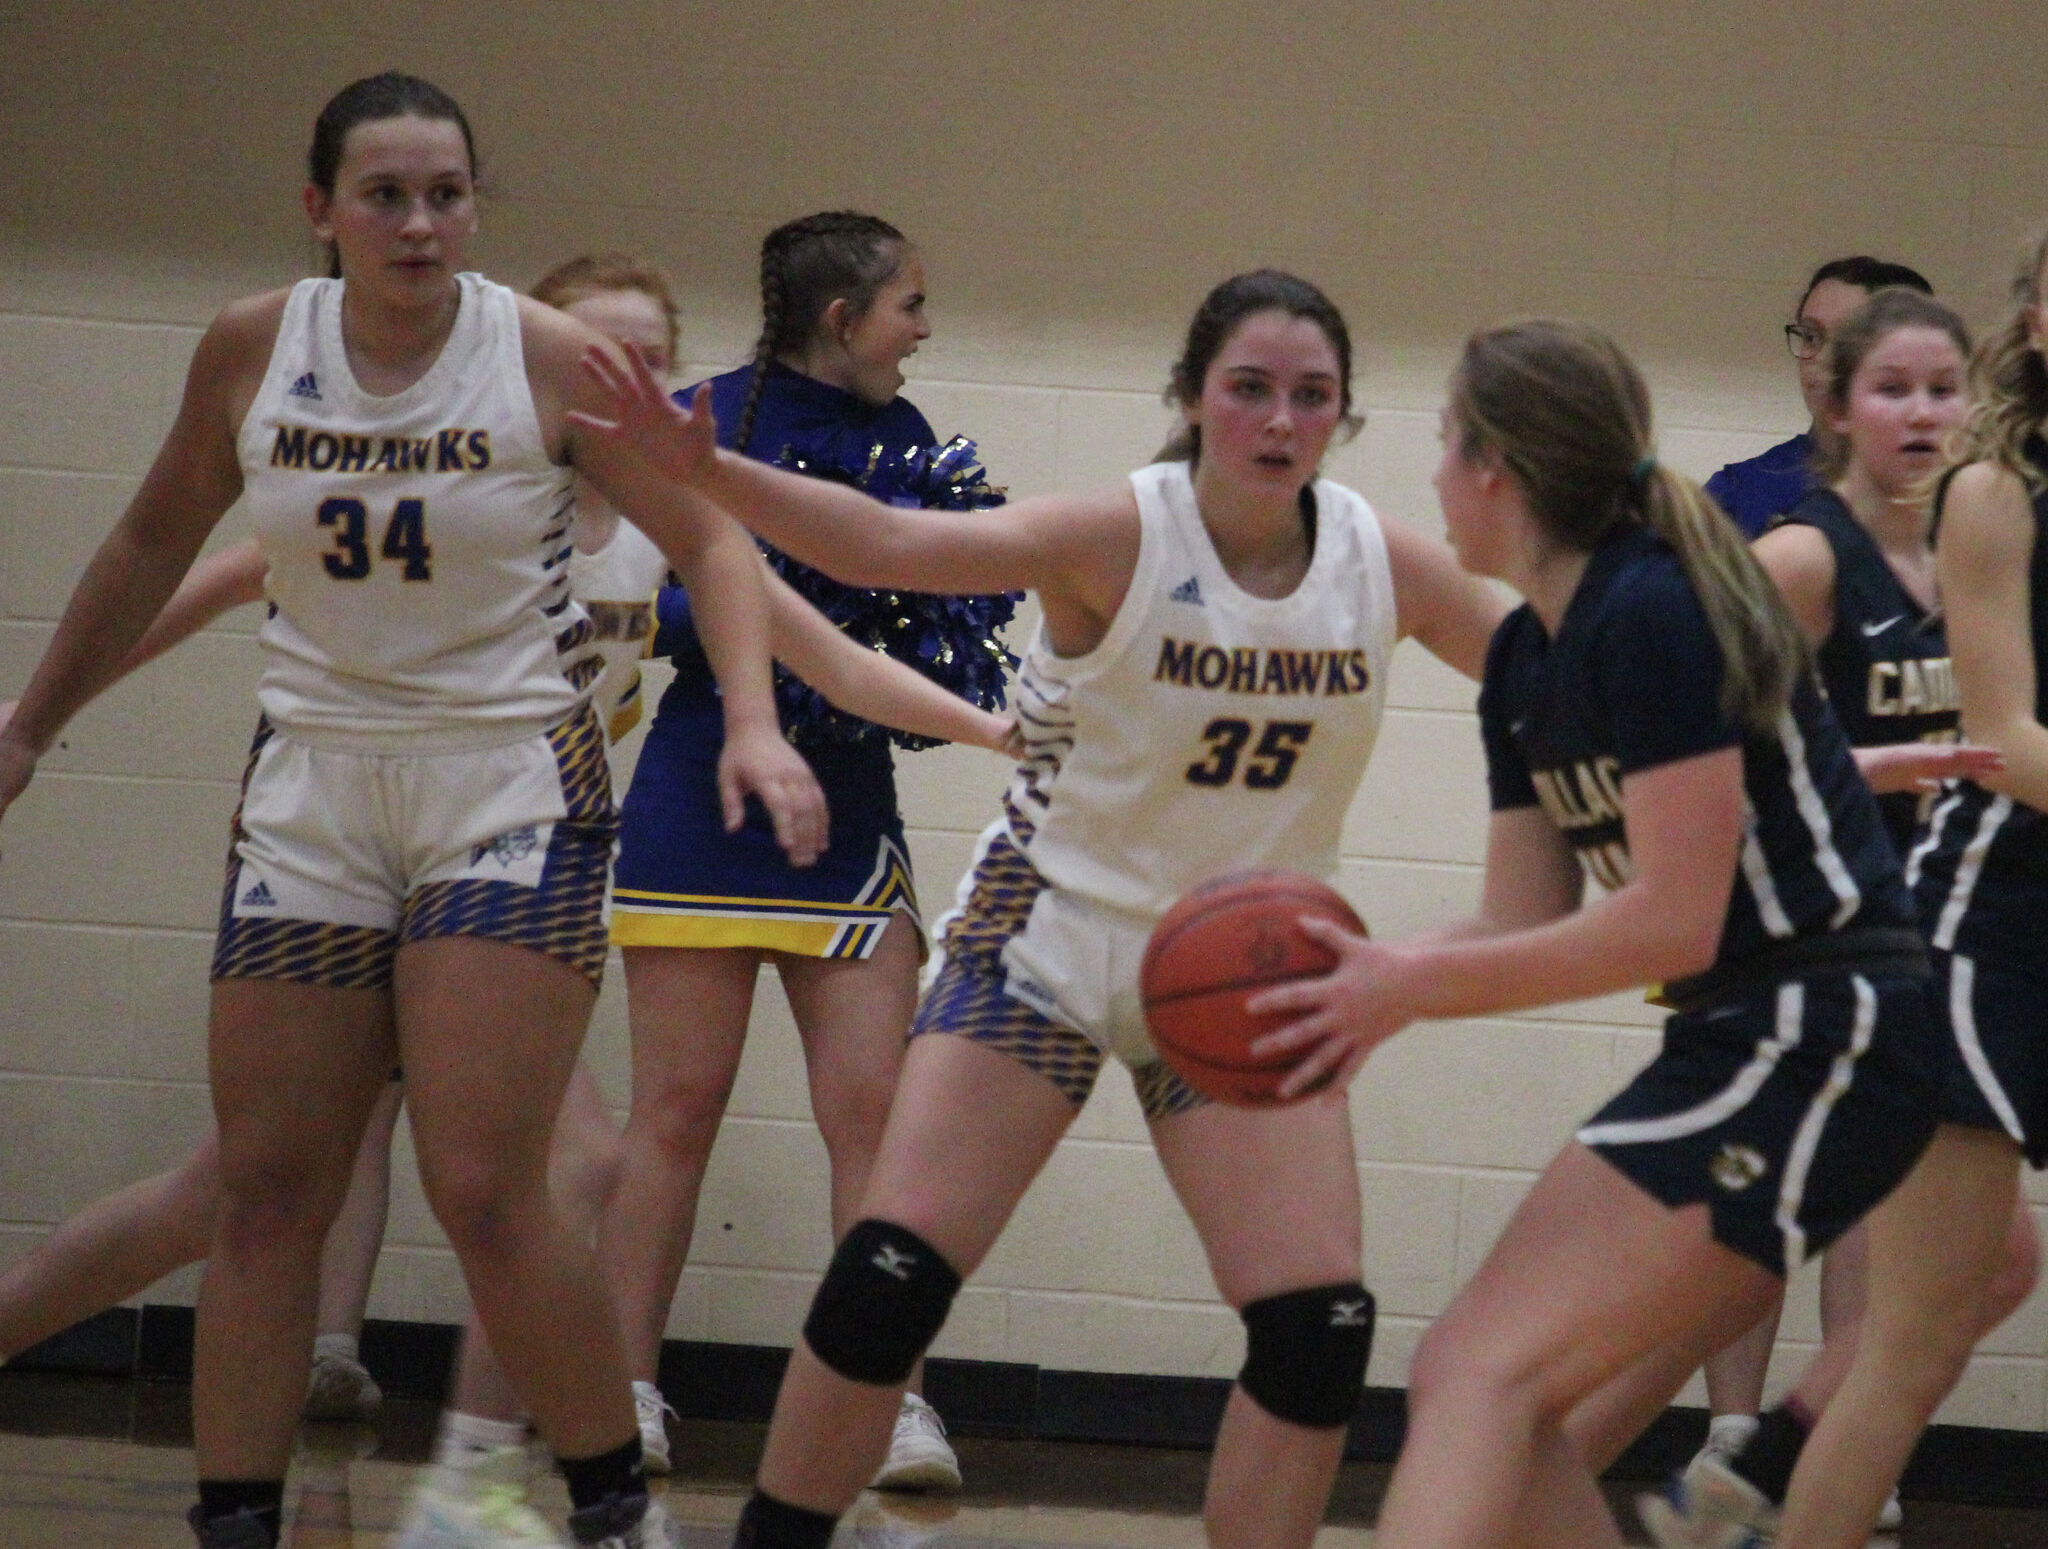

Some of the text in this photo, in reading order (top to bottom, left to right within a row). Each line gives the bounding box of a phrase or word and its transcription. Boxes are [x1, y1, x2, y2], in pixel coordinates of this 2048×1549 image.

[270, 425, 490, 473] MOHAWKS
[317, 497, 432, 582] 34
[1154, 636, 1370, 696] MOHAWKS
[1184, 717, 1314, 790] 35
